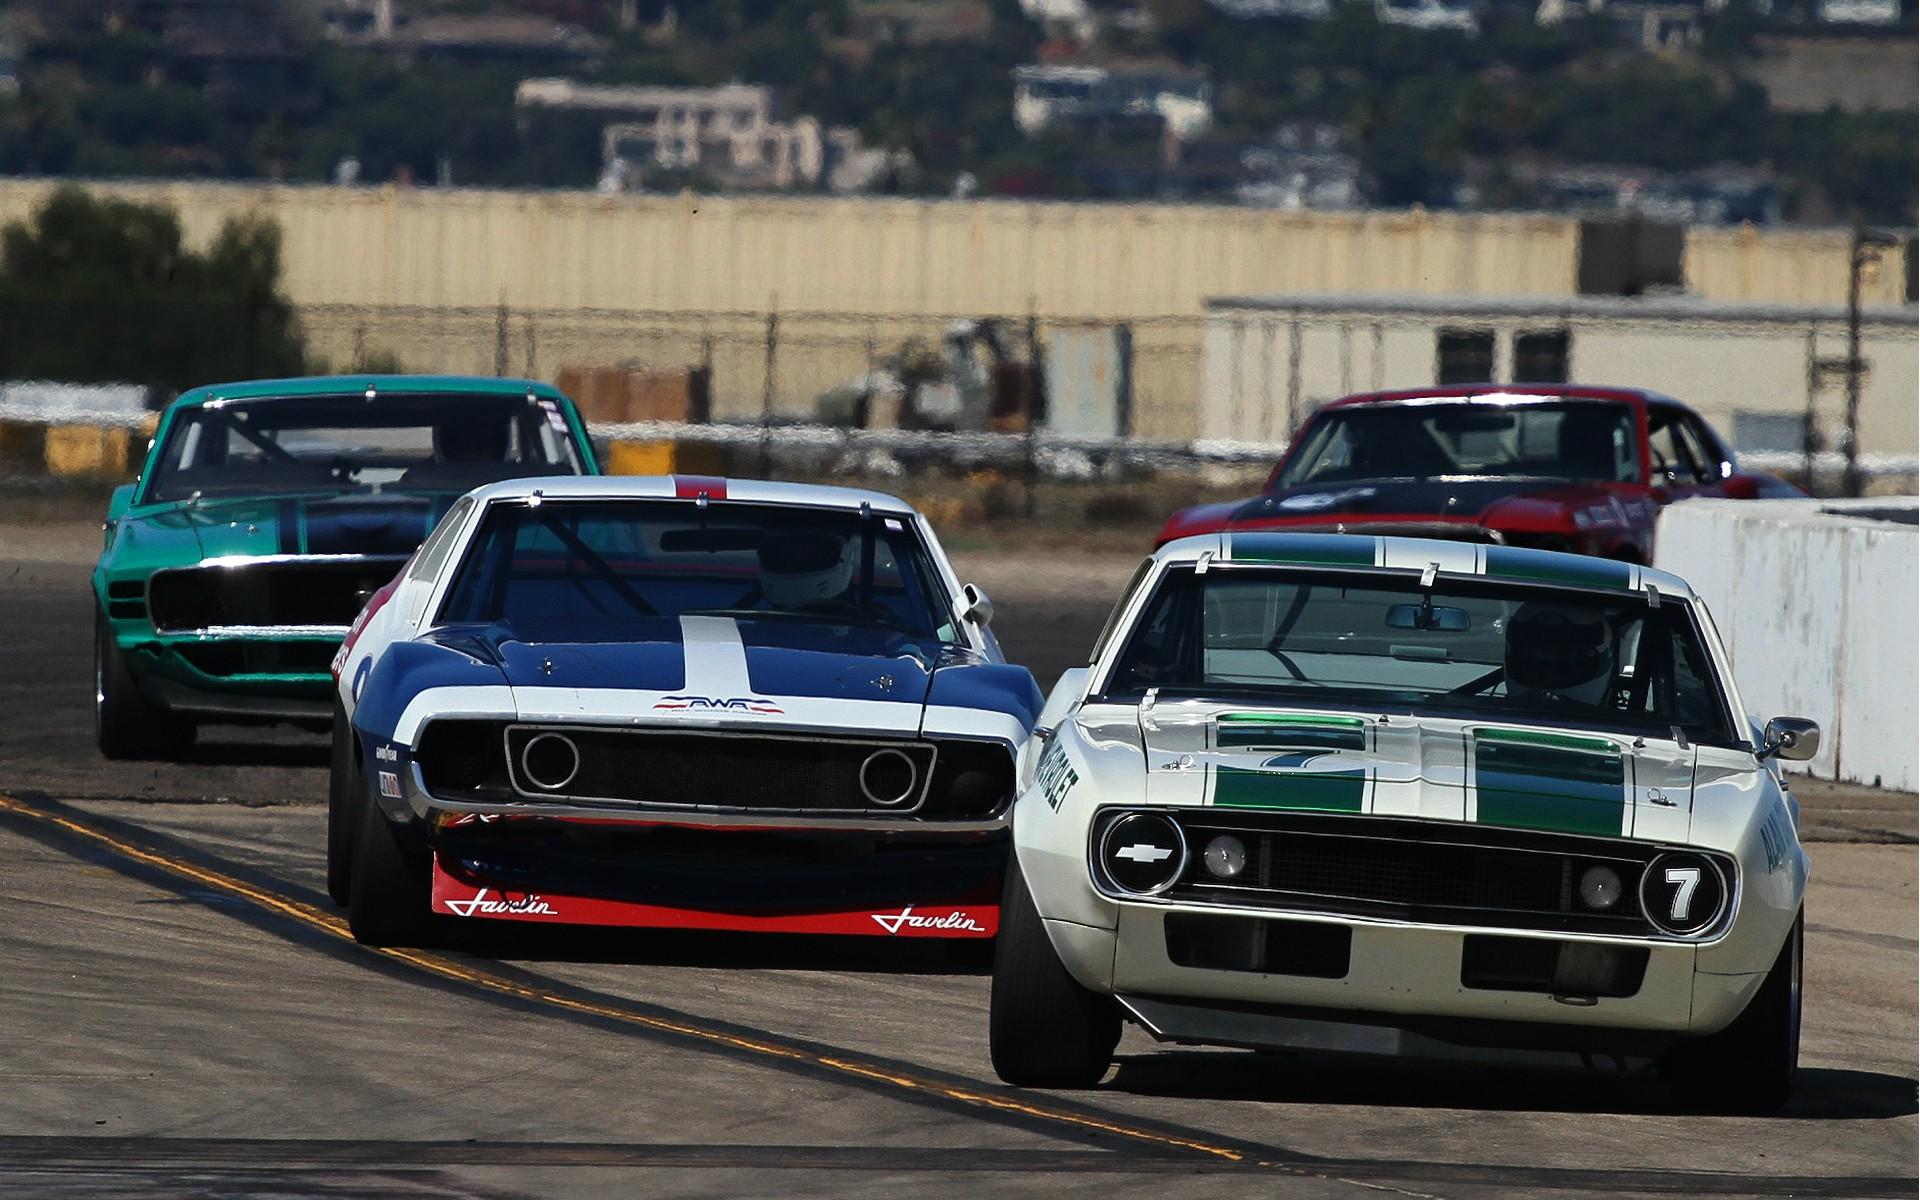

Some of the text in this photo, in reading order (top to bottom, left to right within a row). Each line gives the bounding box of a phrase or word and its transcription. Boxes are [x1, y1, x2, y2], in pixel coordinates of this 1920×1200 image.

[444, 888, 558, 917] Javelin
[1665, 868, 1700, 921] 7
[871, 904, 985, 934] Javelin
